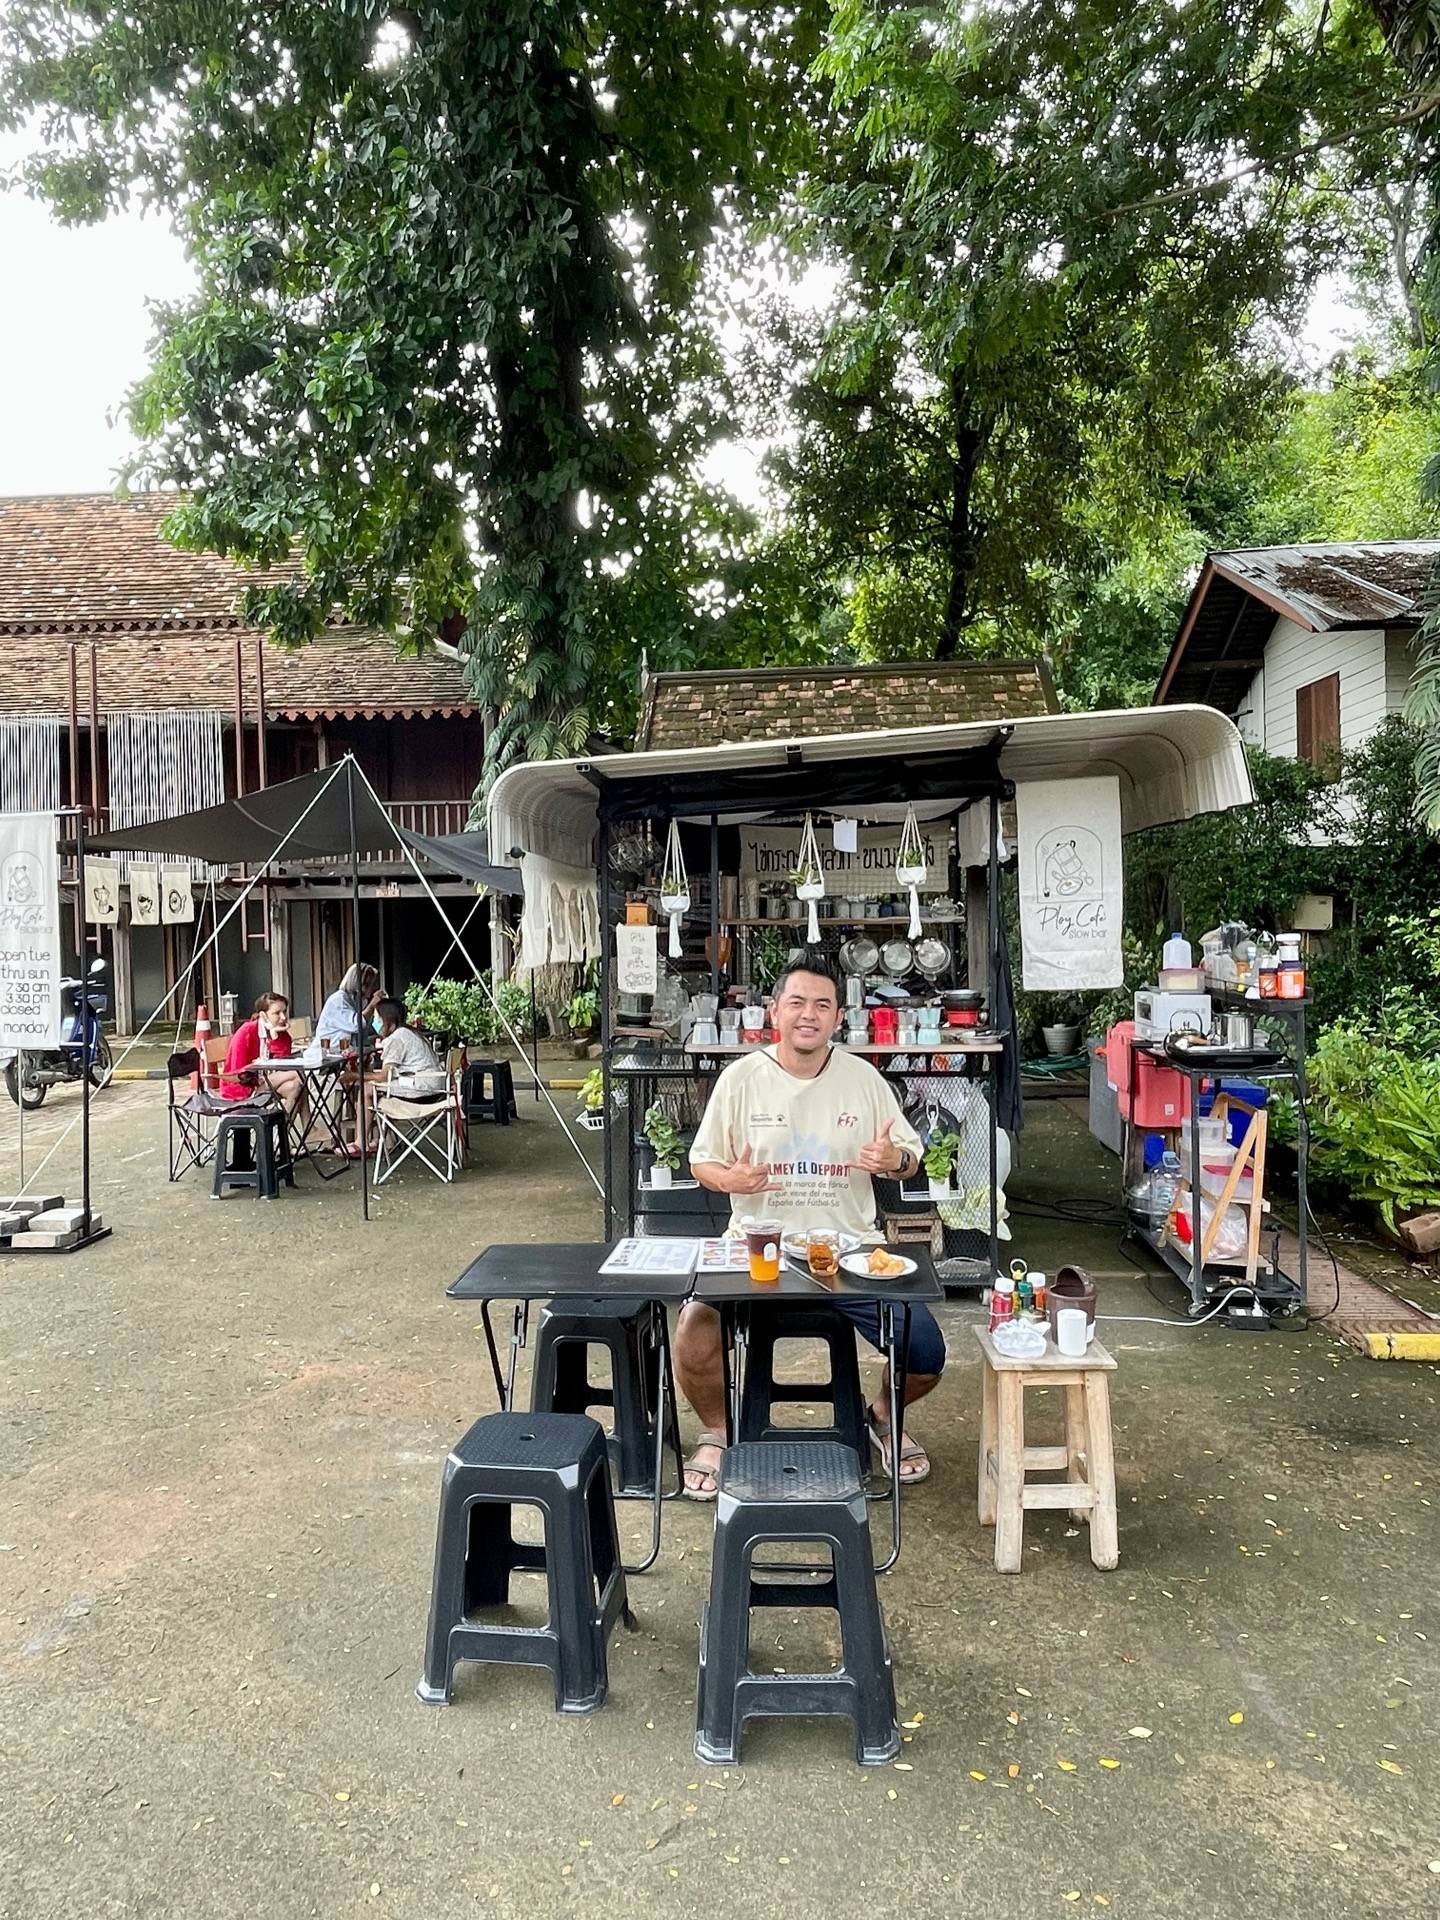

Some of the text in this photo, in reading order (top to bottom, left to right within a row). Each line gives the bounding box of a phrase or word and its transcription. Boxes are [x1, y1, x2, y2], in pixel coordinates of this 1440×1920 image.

[29, 946, 50, 961] tue
[1, 964, 50, 979] thru sun
[32, 982, 50, 993] am
[32, 993, 50, 1006] pm
[1, 1004, 41, 1016] closed
[3, 1020, 50, 1039] monday
[768, 1161, 851, 1177] LMEY EL DEPORT
